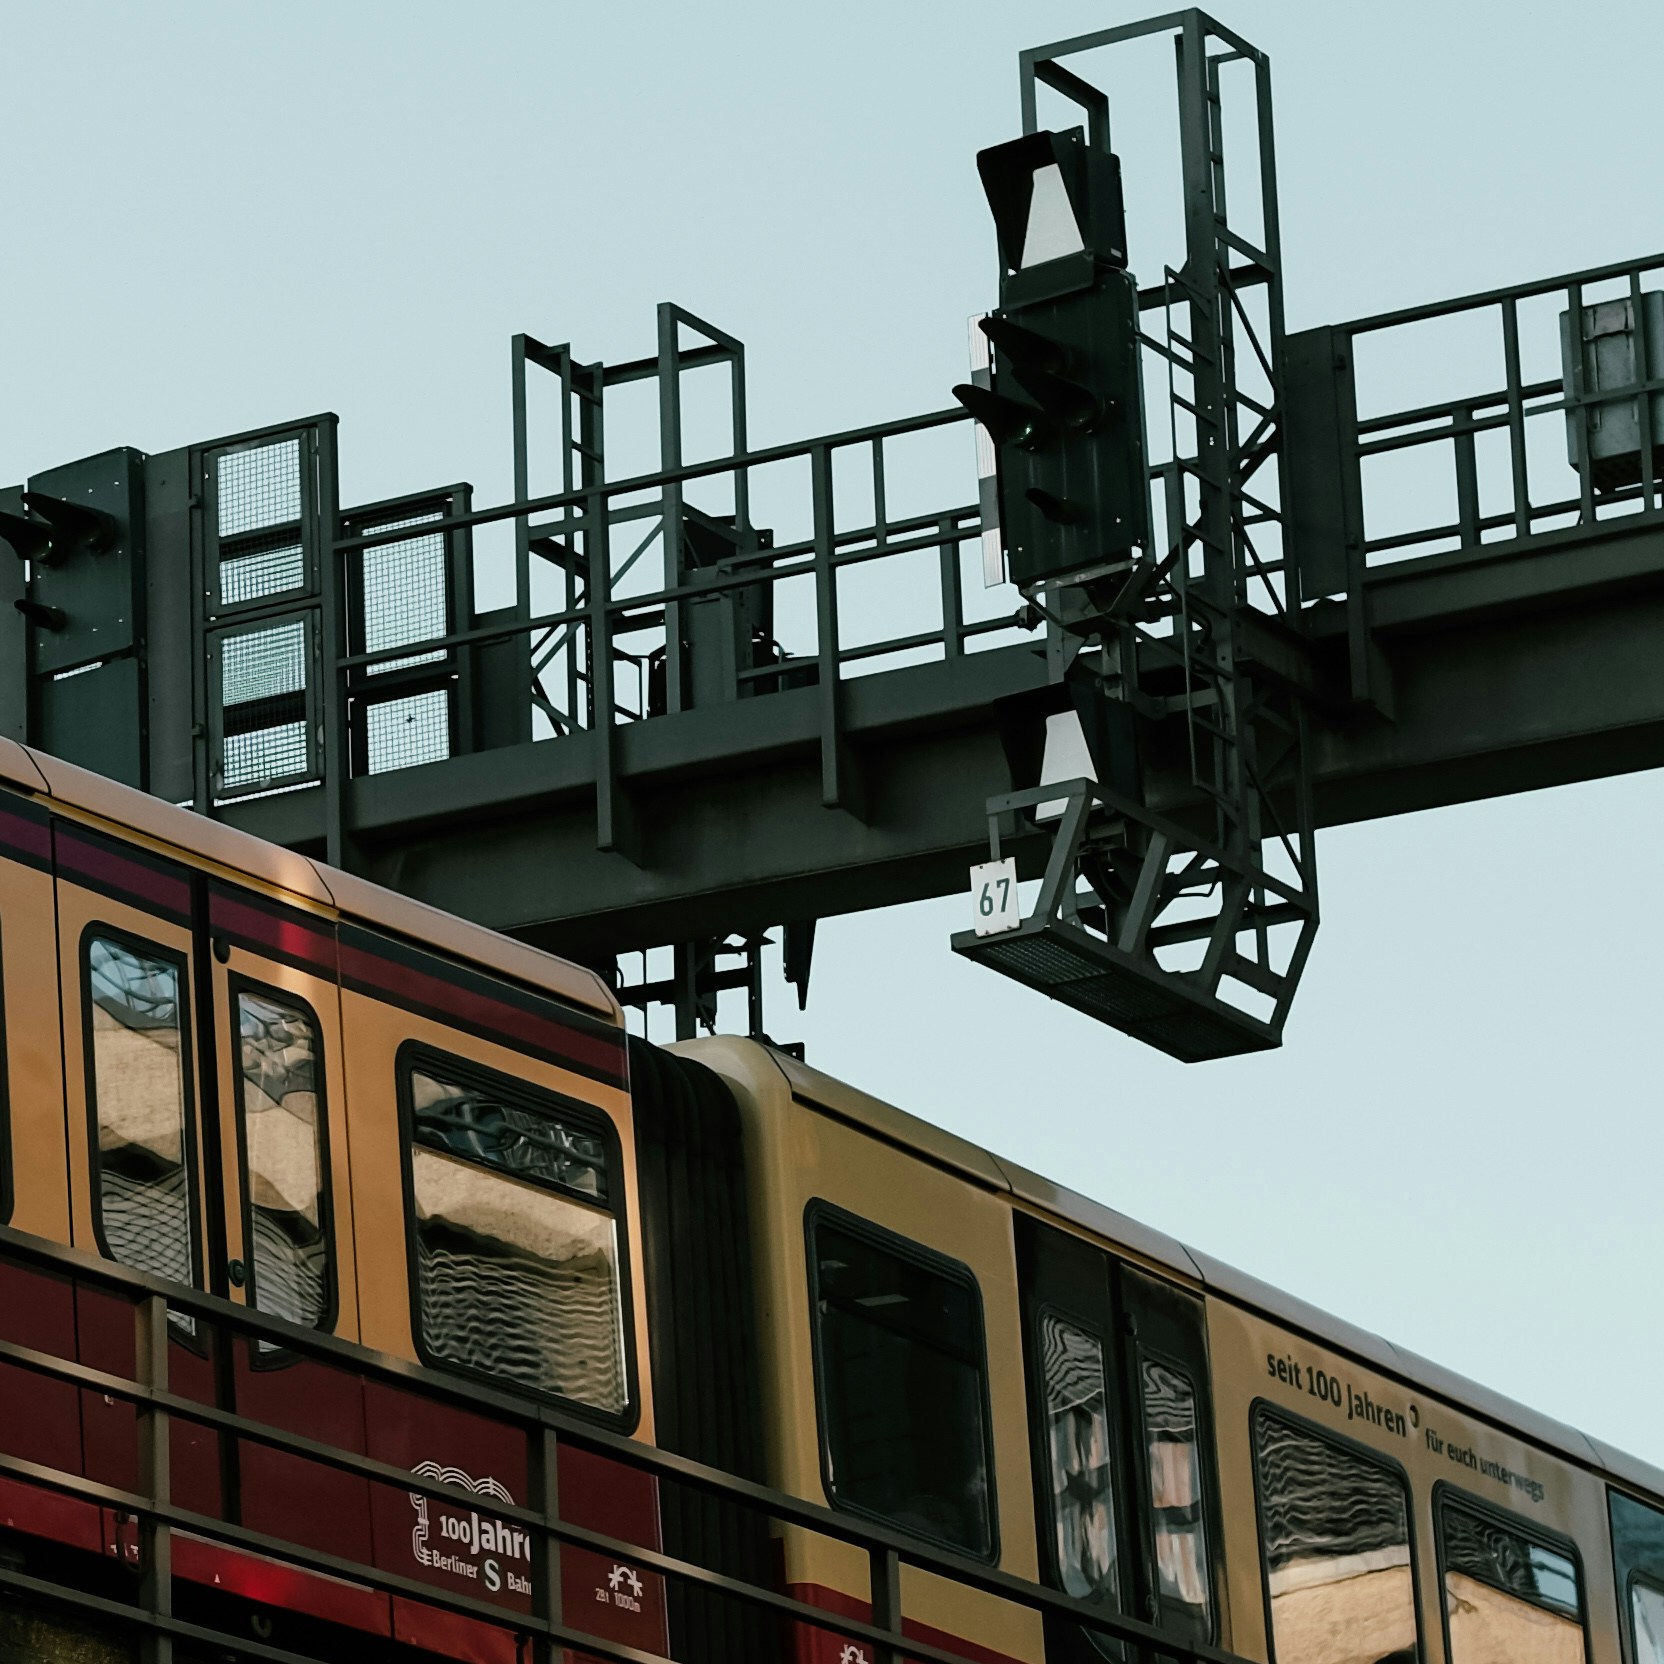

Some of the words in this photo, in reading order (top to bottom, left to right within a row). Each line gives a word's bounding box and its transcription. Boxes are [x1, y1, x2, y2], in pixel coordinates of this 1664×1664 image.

[980, 878, 1010, 916] 67
[1267, 1353, 1302, 1390] seit
[1306, 1366, 1342, 1407] 100
[1347, 1383, 1407, 1438] Jahren
[1425, 1427, 1443, 1453] für
[1447, 1441, 1478, 1471] euch
[1479, 1457, 1545, 1503] unterwegs
[432, 1549, 478, 1579] Berliner
[485, 1558, 501, 1592] S
